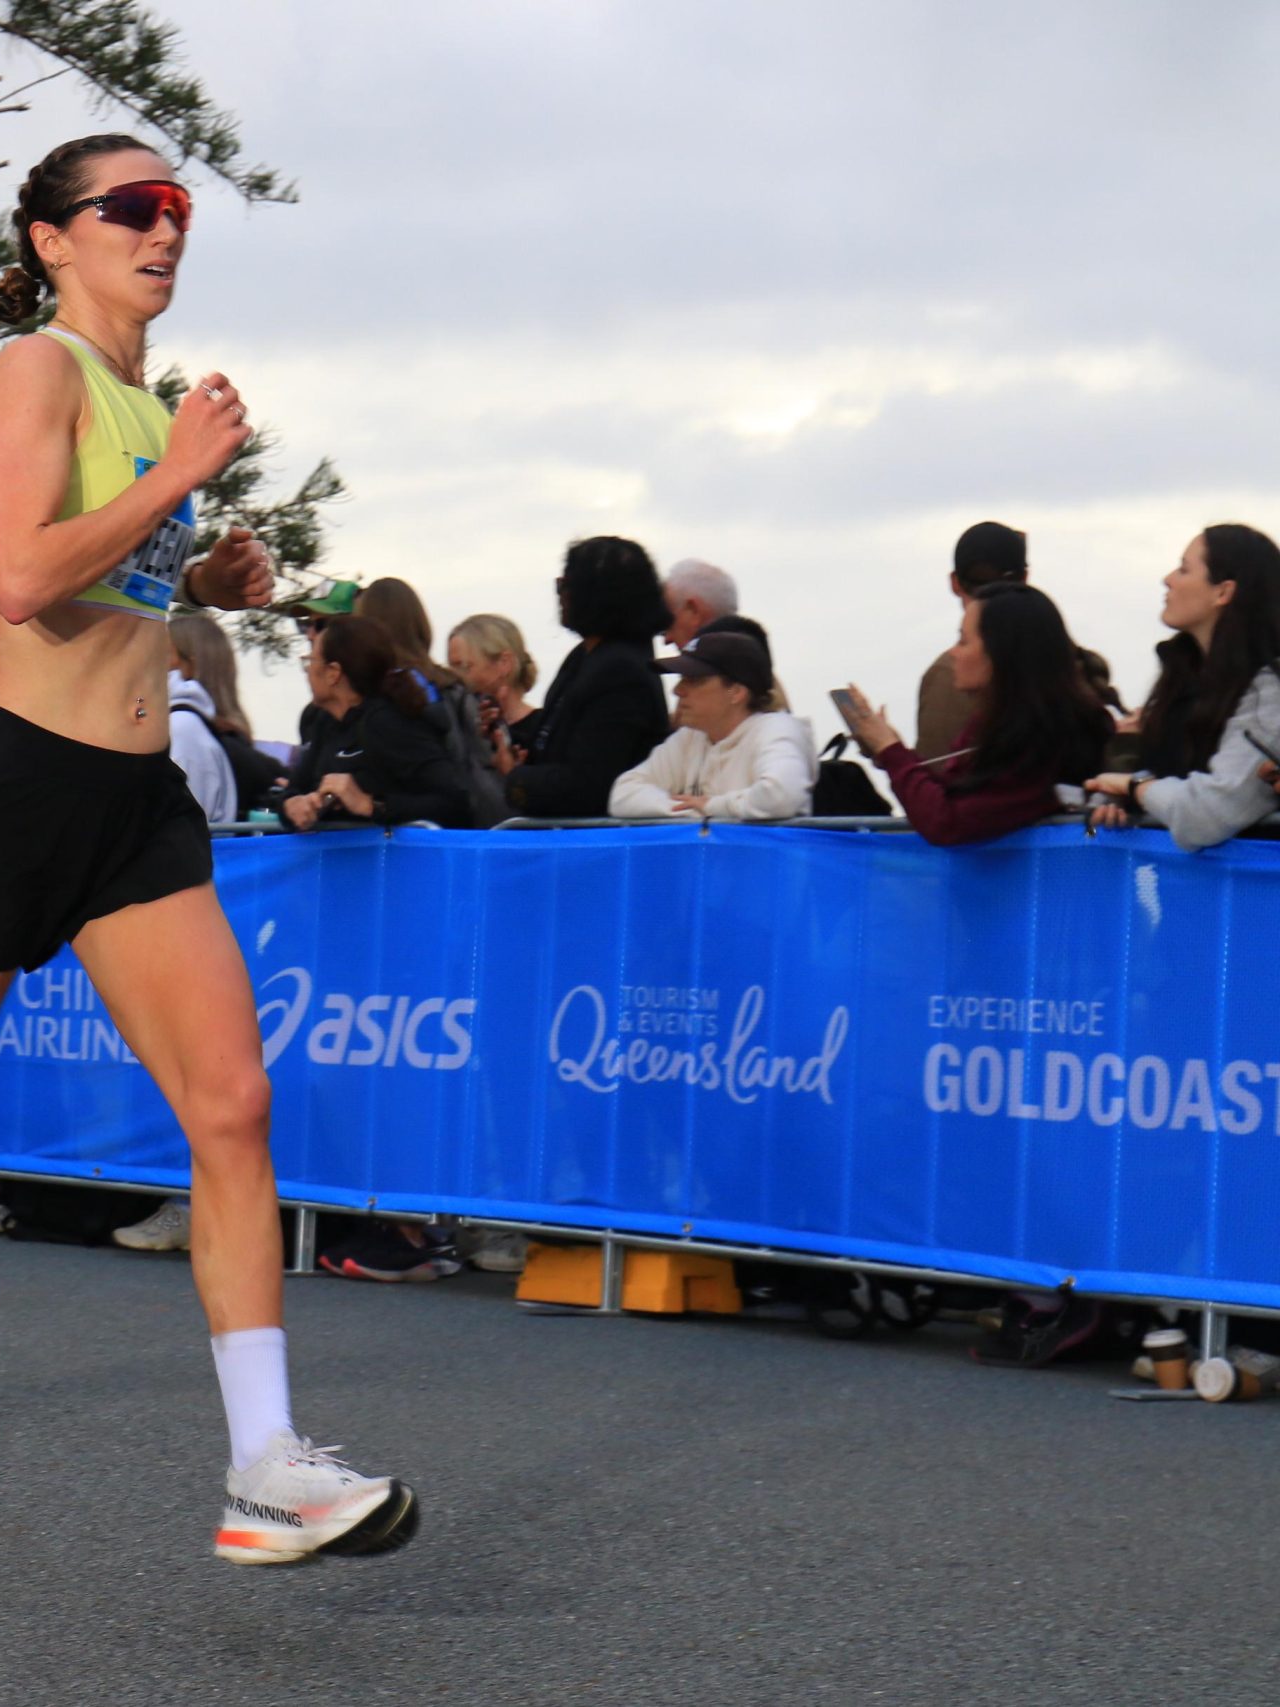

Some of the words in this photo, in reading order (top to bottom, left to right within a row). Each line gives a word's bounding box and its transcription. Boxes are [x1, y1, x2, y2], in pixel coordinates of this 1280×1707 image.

[620, 986, 719, 1010] TOURISM
[619, 1011, 634, 1033] &
[638, 1012, 719, 1037] EVENTS
[928, 995, 1106, 1036] EXPERIENCE
[549, 985, 849, 1104] Queensland
[234, 1497, 303, 1528] RUNNING
